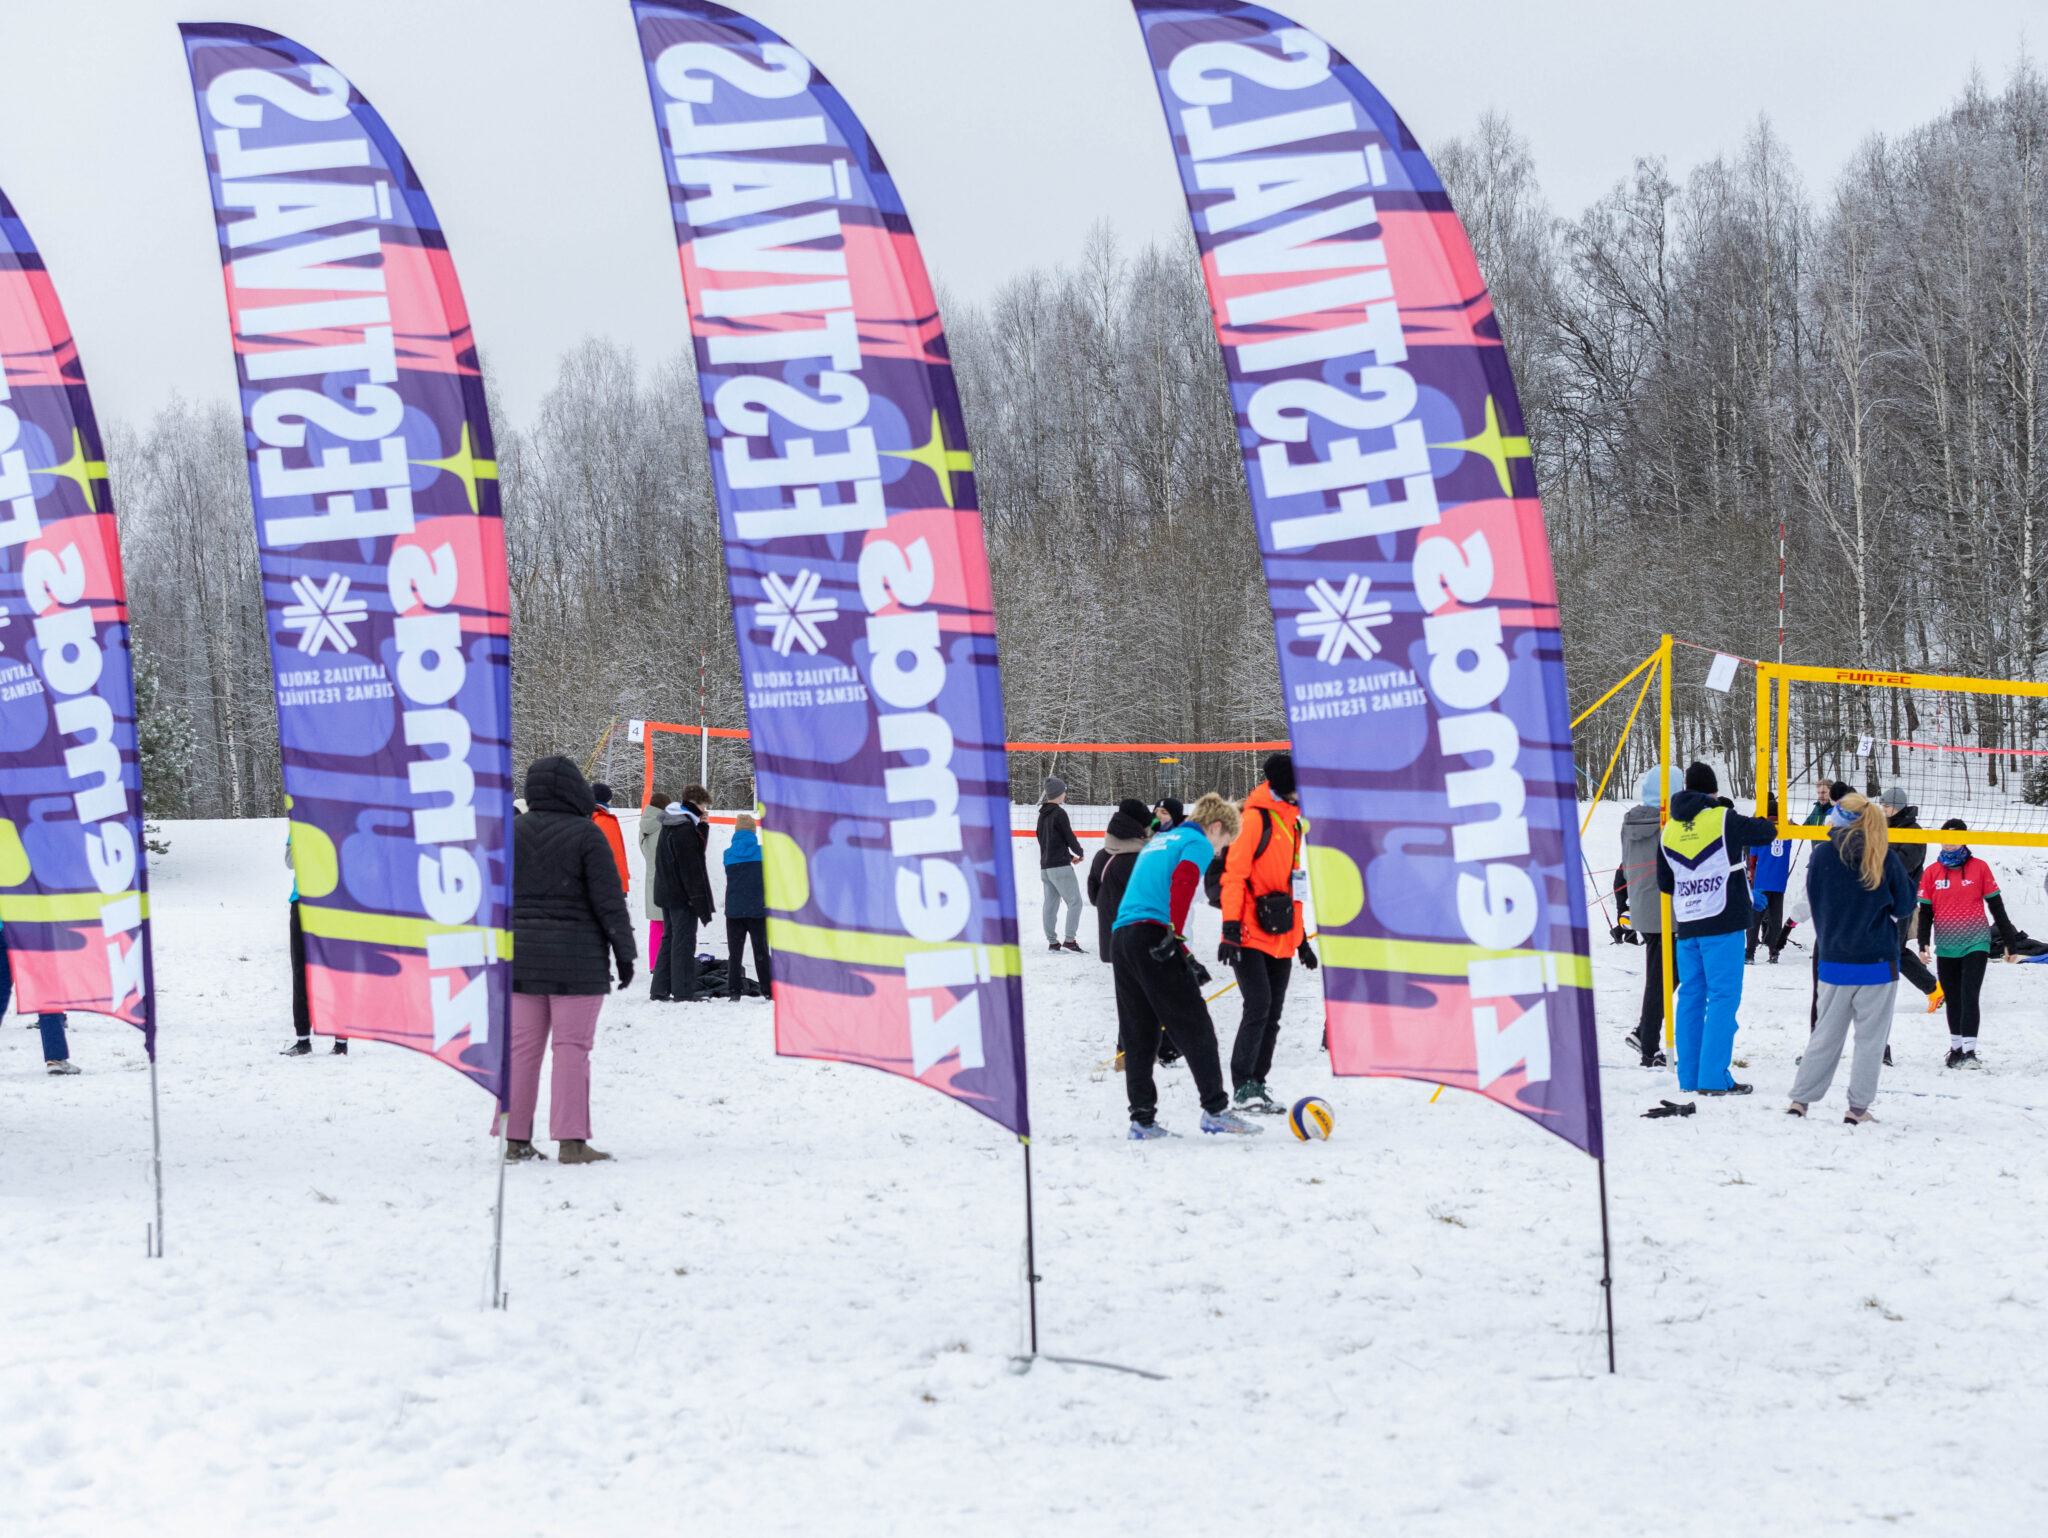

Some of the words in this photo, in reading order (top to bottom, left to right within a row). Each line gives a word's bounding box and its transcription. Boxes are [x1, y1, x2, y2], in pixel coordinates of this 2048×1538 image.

[1836, 671, 1912, 685] FUNTEC
[632, 727, 640, 736] 4
[1861, 741, 1869, 752] 5
